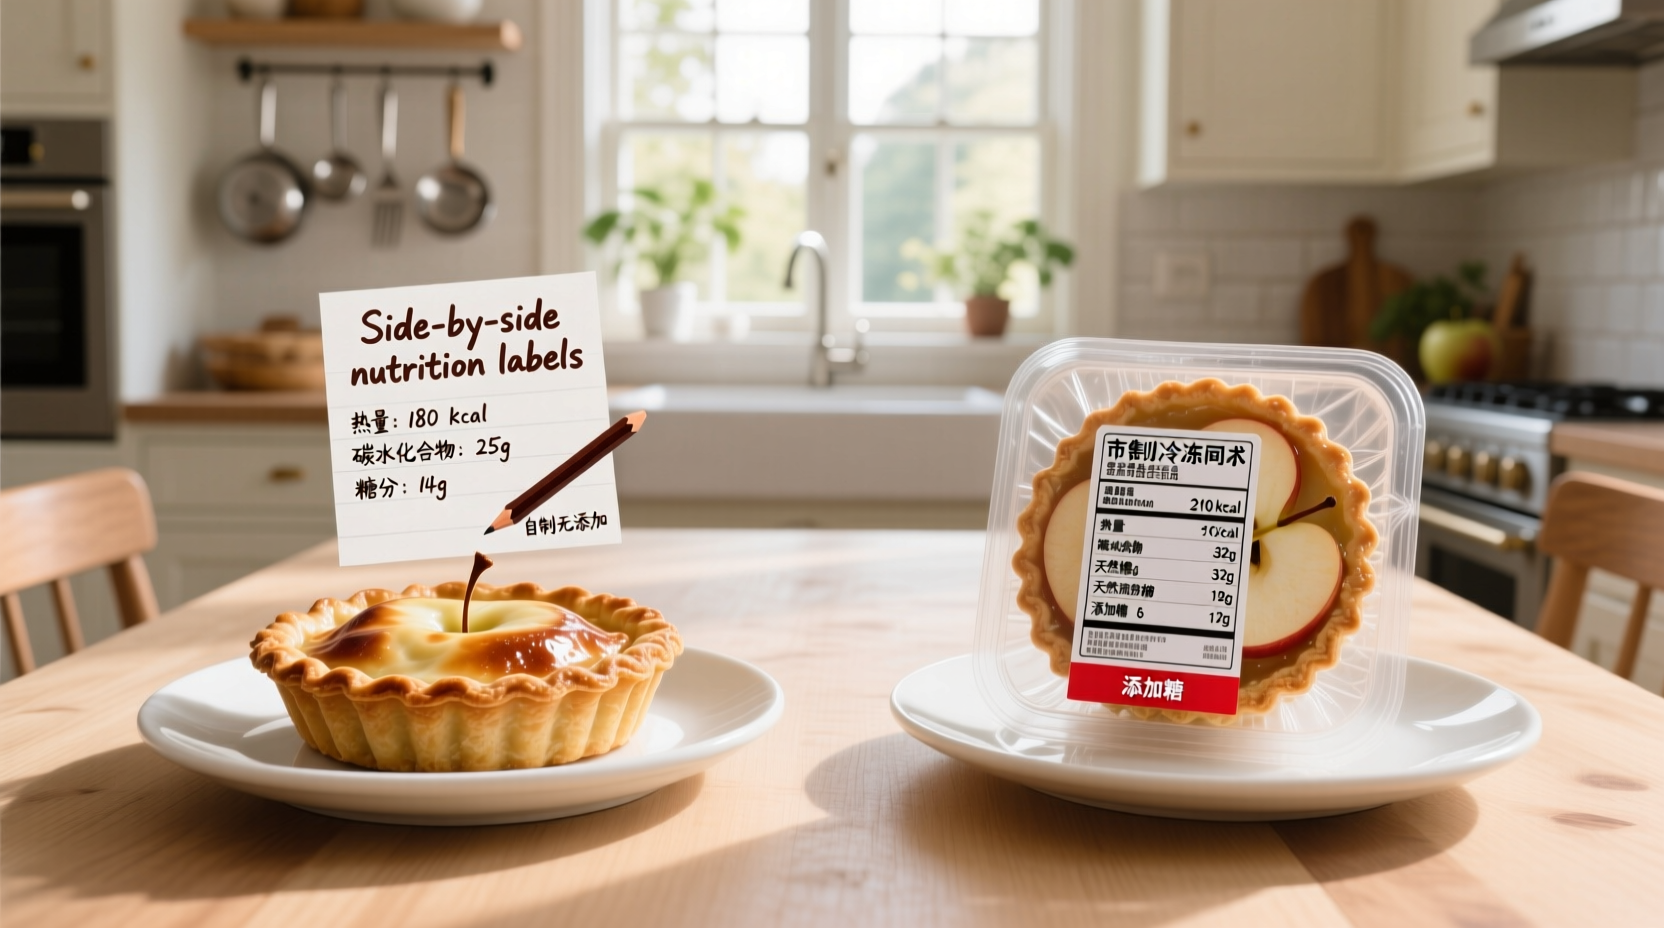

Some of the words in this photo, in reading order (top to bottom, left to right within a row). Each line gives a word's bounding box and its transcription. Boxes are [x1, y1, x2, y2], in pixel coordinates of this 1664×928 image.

[360, 298, 560, 351] Side-by-side
[351, 352, 485, 386] nutrition
[499, 337, 584, 375] labels
[408, 408, 439, 428] 180
[449, 402, 487, 425] kcal
[475, 436, 511, 462] 25g
[419, 475, 447, 500] 14g
[525, 511, 608, 536] 自制无添加
[1211, 568, 1234, 585] 32g
[1121, 675, 1184, 701] 添加糖
